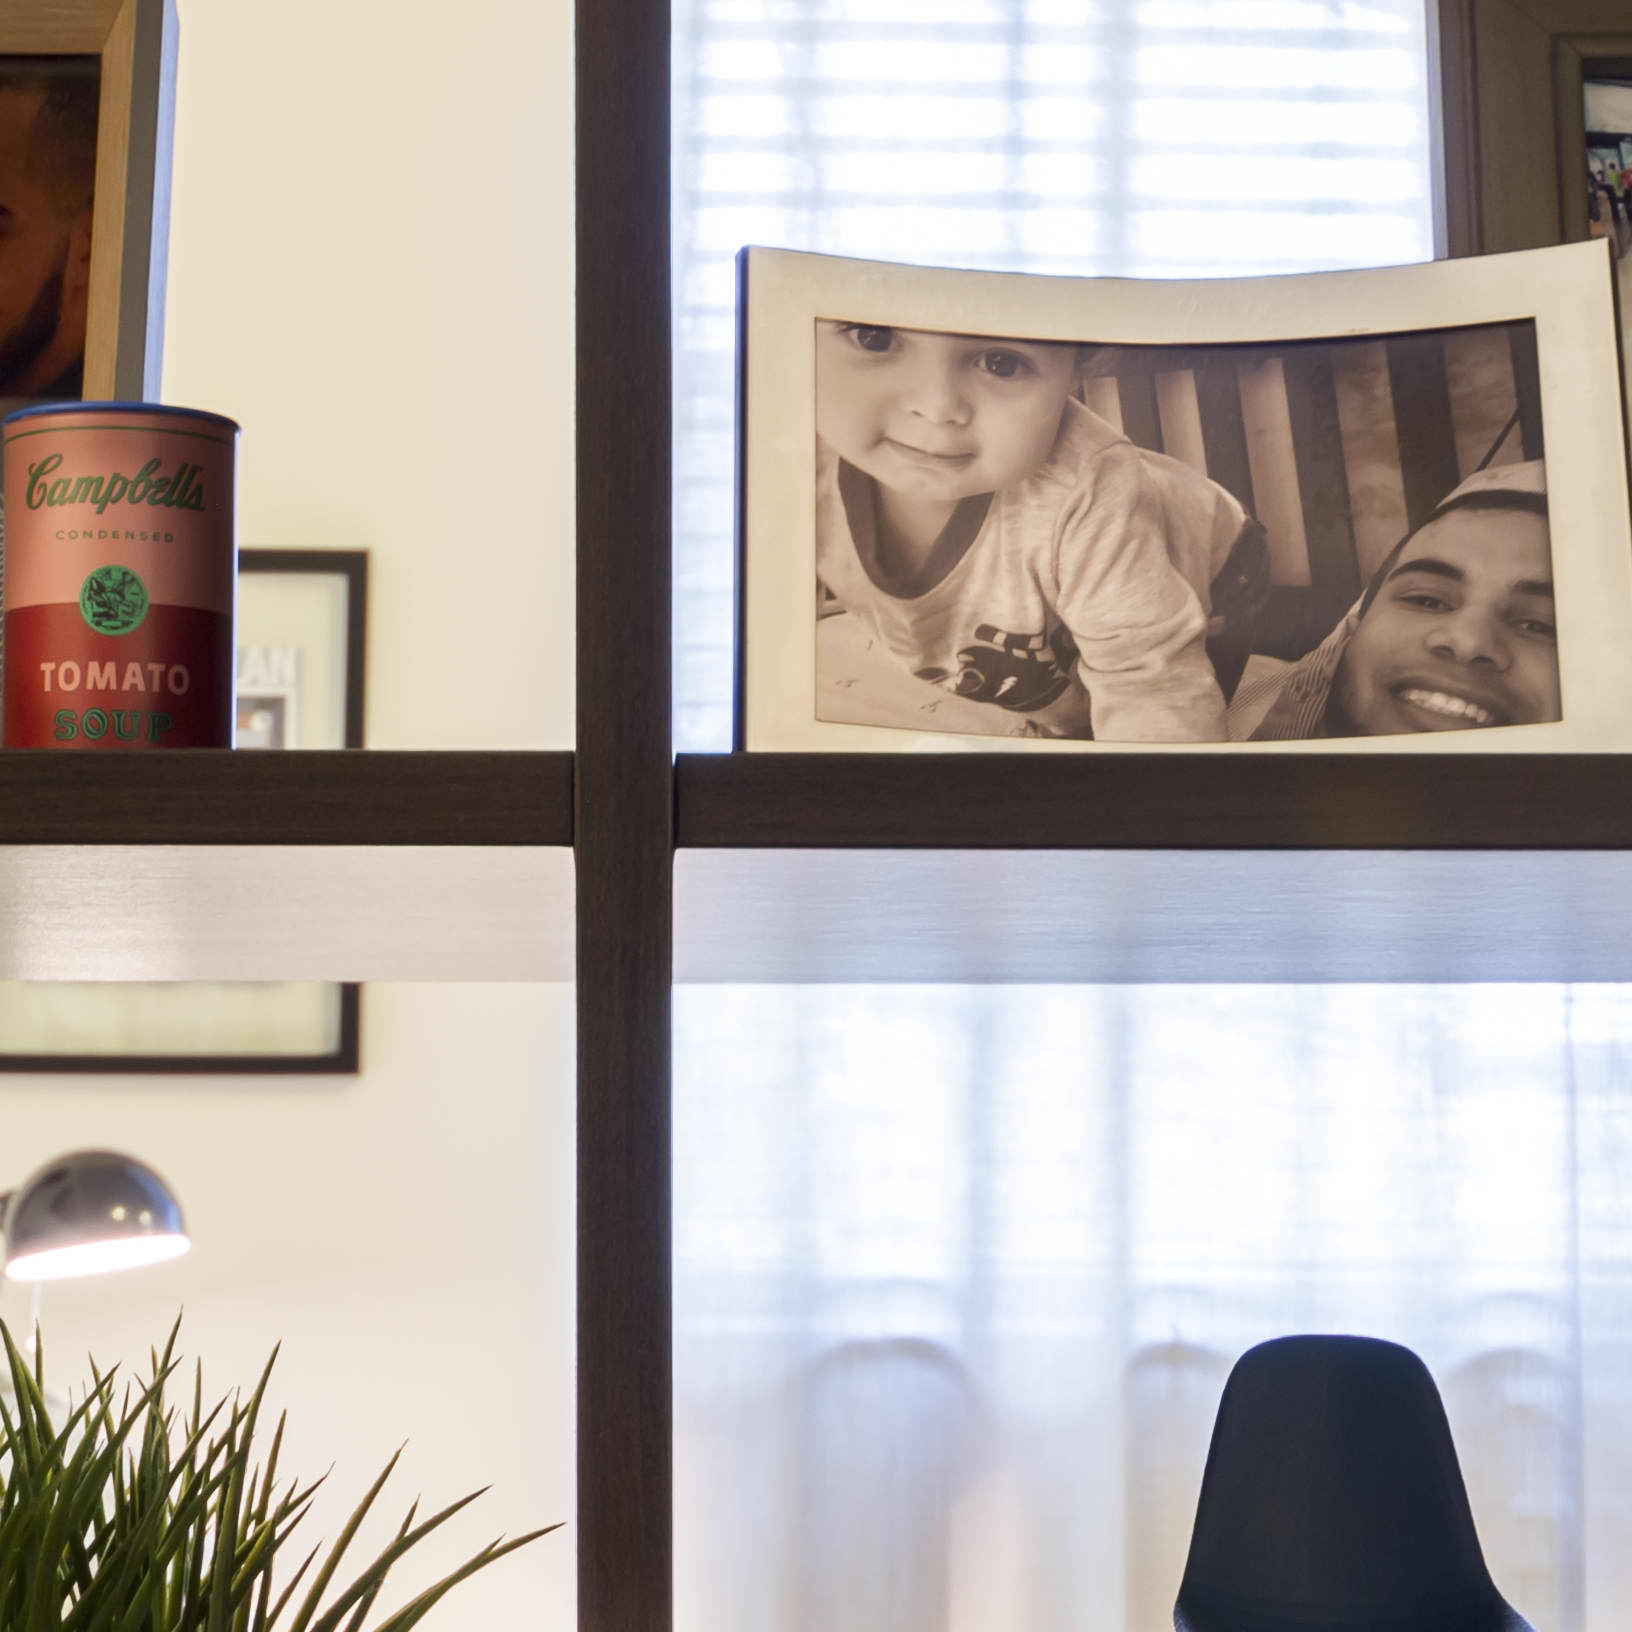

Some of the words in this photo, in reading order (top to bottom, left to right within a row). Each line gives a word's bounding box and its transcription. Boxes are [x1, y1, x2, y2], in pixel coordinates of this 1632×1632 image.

[55, 529, 175, 544] CONDENSED
[40, 660, 190, 696] TOMATO
[54, 707, 174, 743] SOUP
